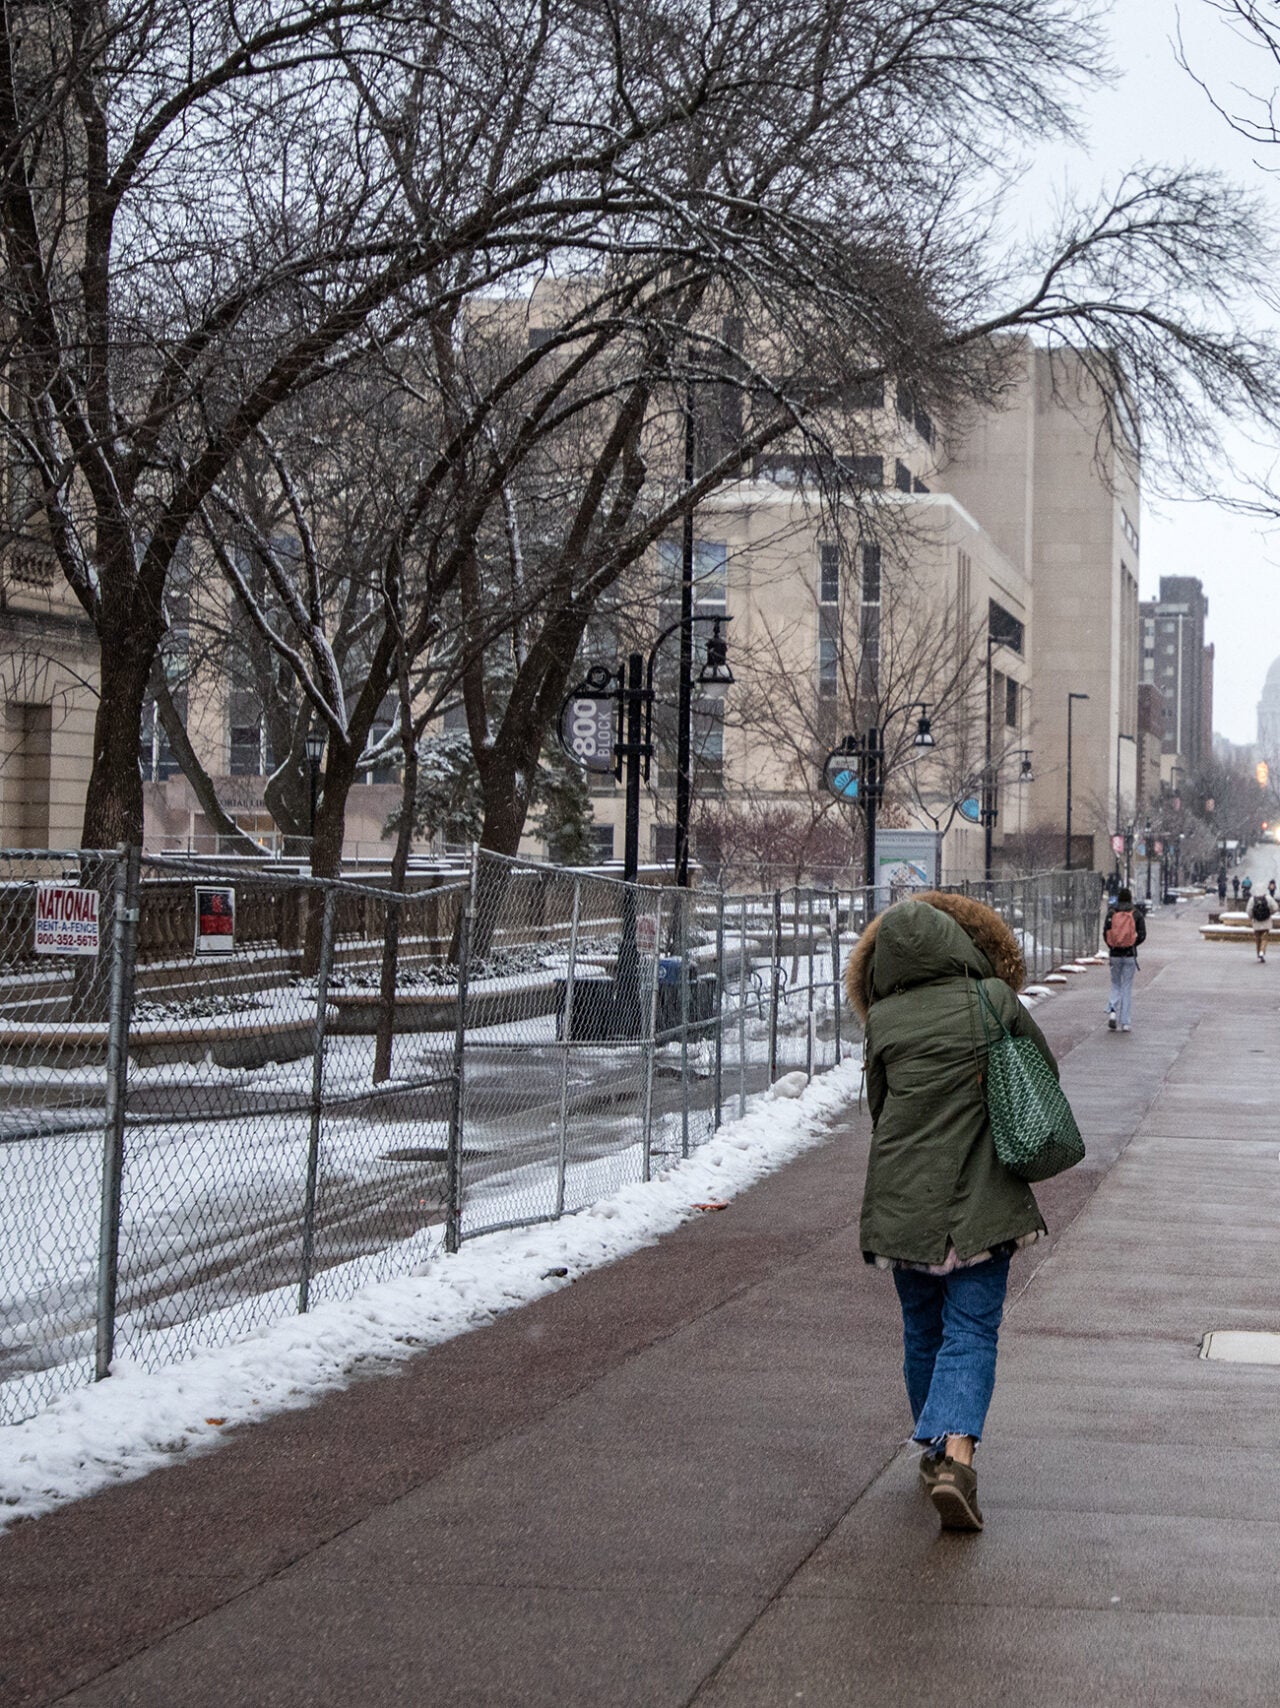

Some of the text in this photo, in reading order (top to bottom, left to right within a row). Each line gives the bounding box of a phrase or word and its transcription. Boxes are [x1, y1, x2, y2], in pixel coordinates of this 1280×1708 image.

[573, 699, 597, 757] 800
[597, 711, 611, 757] BLOCK
[38, 889, 97, 922] NATIONAL
[37, 921, 98, 934] RENT-A-FENCE
[37, 932, 98, 947] 800-352-5675
